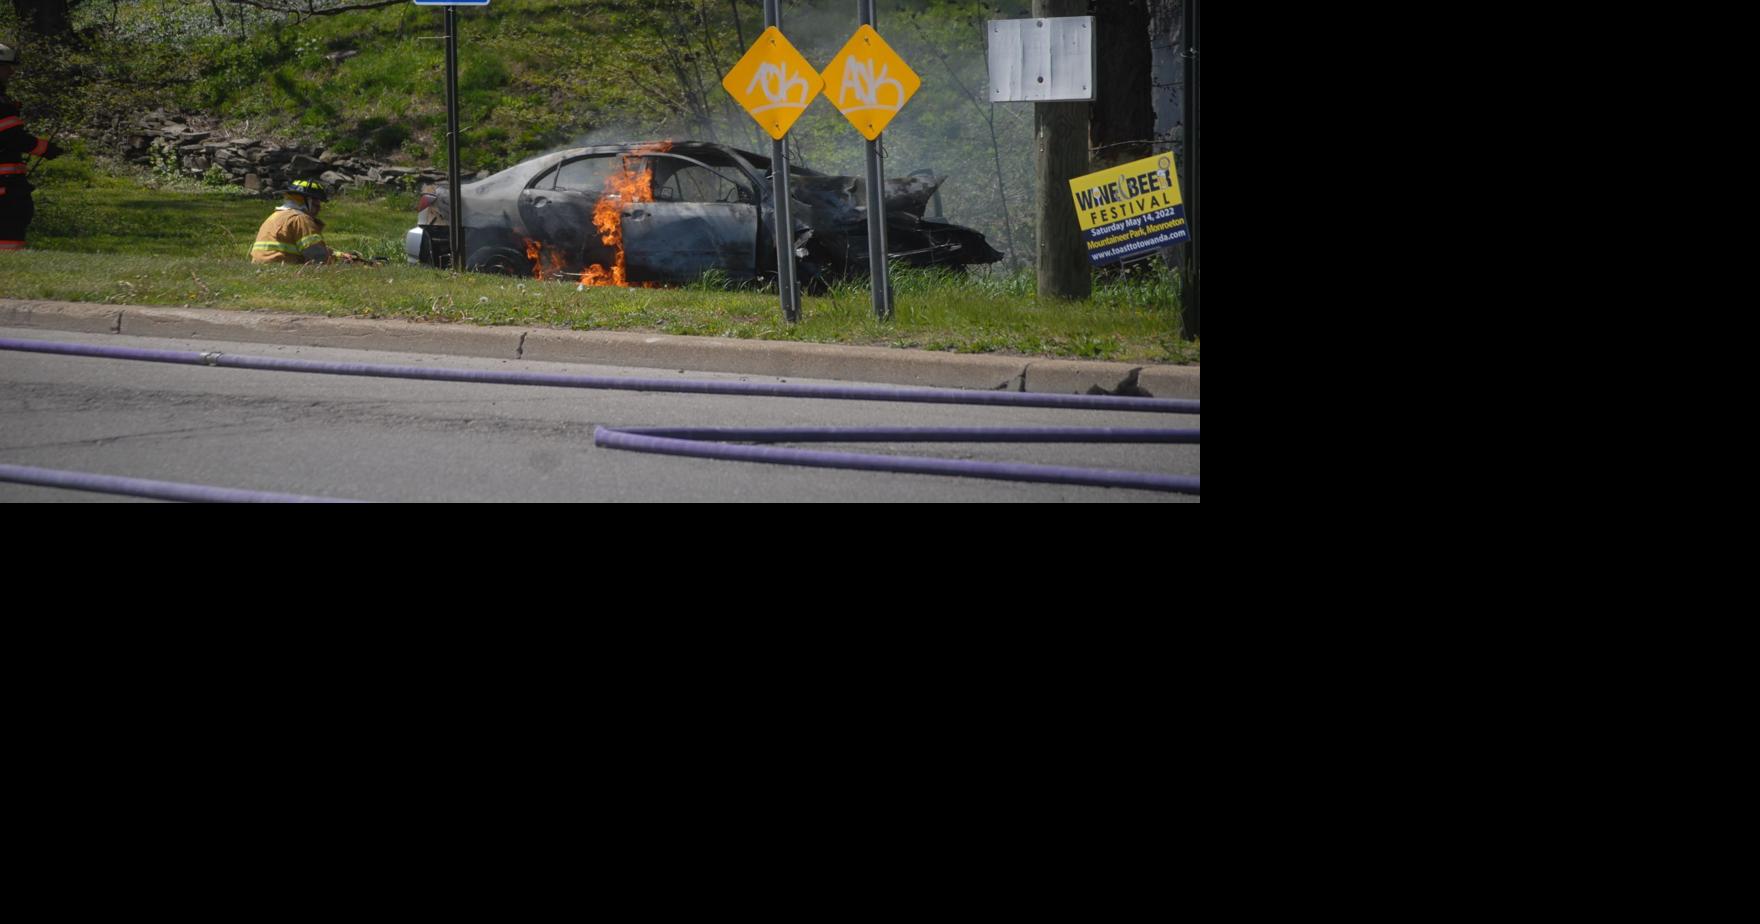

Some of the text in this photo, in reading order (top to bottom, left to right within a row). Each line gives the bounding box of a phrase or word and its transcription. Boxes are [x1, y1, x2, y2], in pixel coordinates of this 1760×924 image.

[1090, 192, 1171, 225] FESTIVAL
[1090, 207, 1175, 237] Saturday May 14, 2022
[1087, 217, 1185, 250] Mountaineer Park, Monroeton
[1092, 230, 1185, 260] www.toasttotowanda.com
